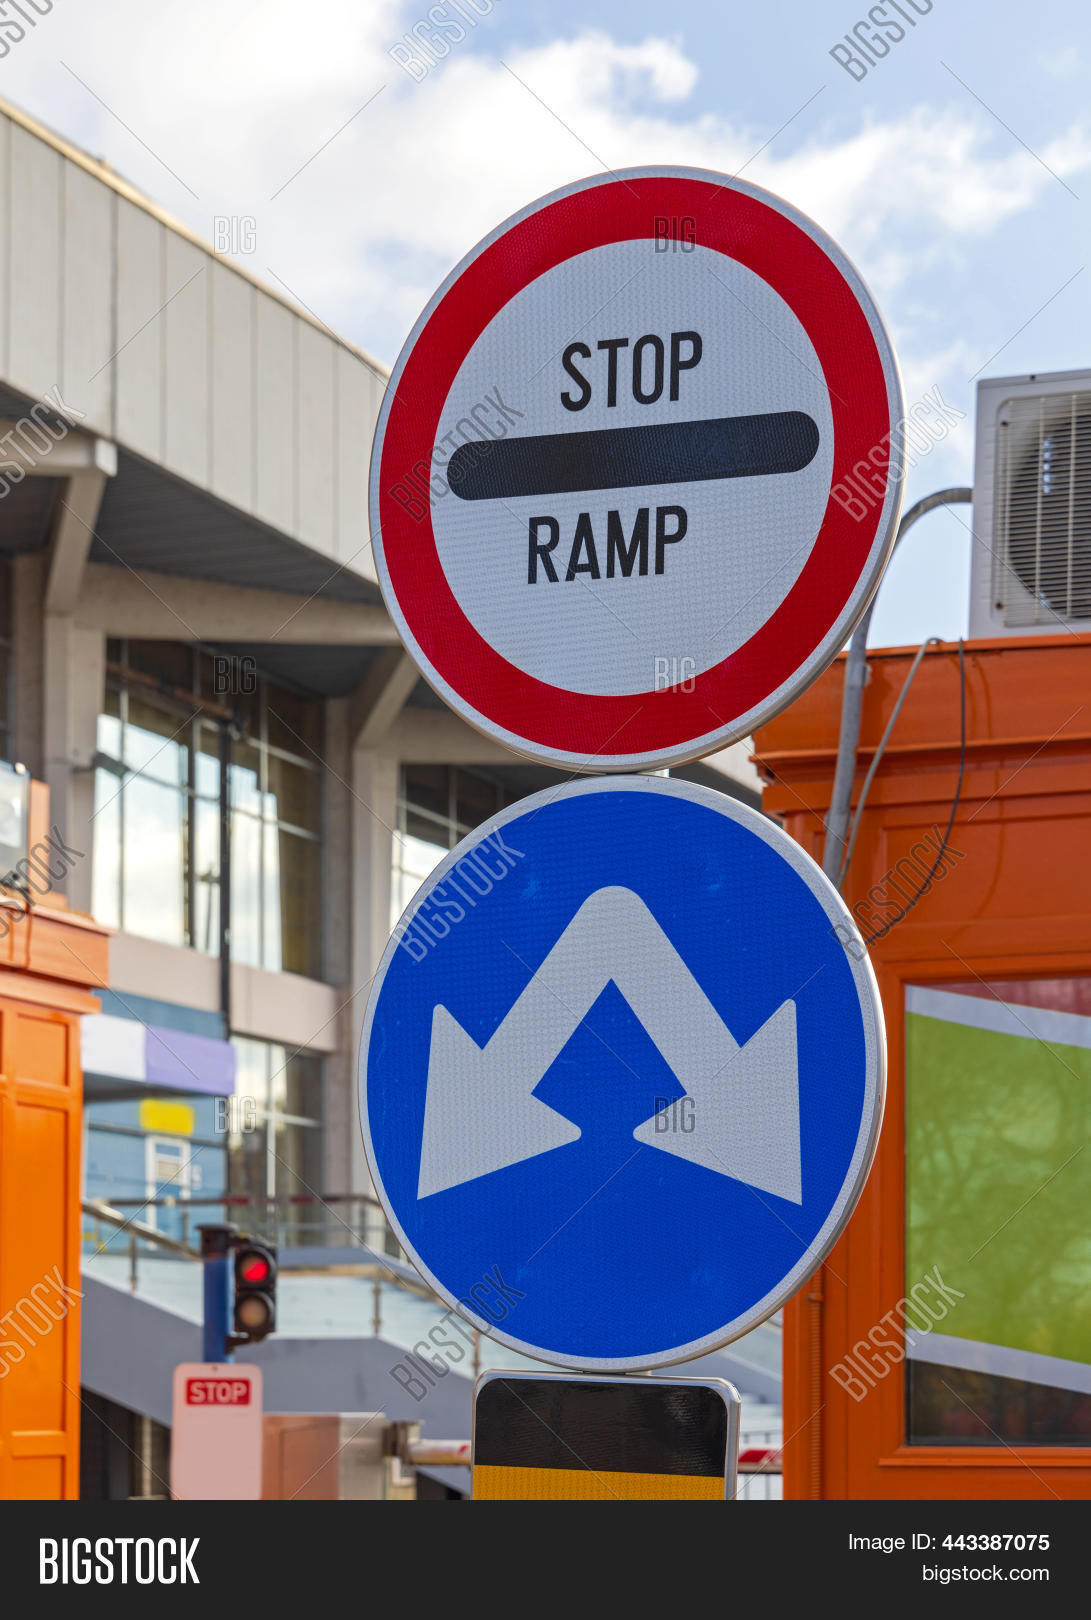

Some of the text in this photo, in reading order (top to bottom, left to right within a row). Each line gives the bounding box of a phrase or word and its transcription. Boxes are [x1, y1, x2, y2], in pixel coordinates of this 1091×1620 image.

[561, 331, 702, 411] STOP
[528, 506, 687, 584] RAMP
[190, 1382, 247, 1403] STOP
